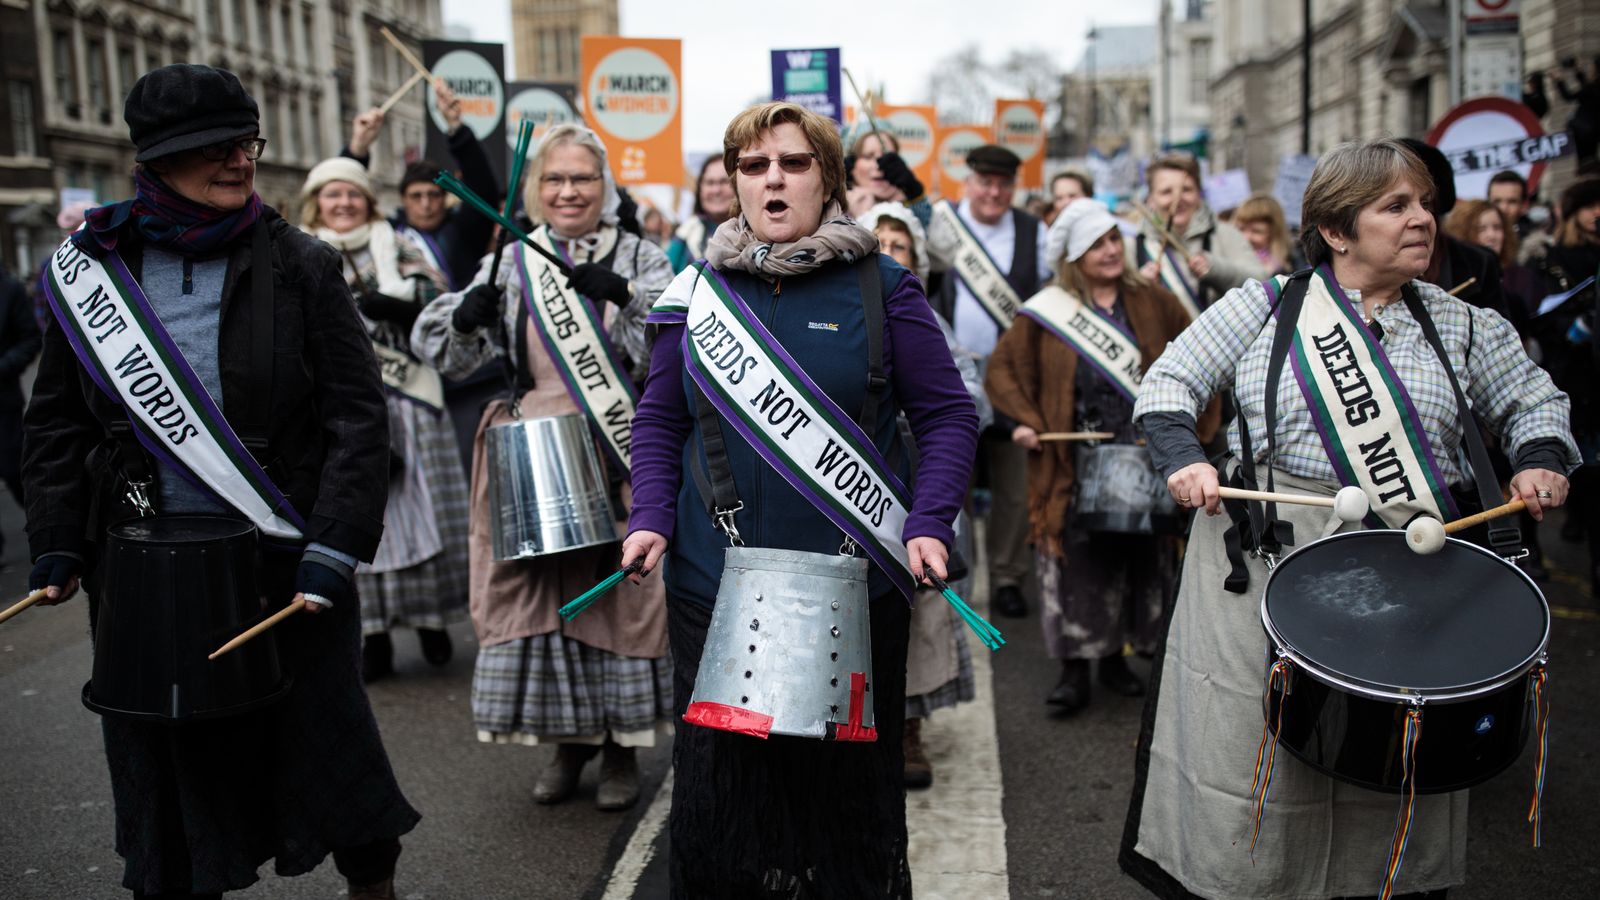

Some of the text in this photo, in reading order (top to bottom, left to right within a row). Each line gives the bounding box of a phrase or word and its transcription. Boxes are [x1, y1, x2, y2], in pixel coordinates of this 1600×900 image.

[598, 74, 670, 93] #MARCH
[1475, 145, 1519, 170] THE
[1521, 132, 1568, 162] GAP
[77, 284, 128, 344] NOT
[114, 343, 199, 446] WORDS
[539, 264, 580, 341] DEEDS
[570, 344, 611, 392] NOT
[1067, 311, 1124, 361] DEEDS
[690, 311, 893, 528] DEEDS NOT WORDS
[1311, 322, 1417, 505] DEEDS NOT
